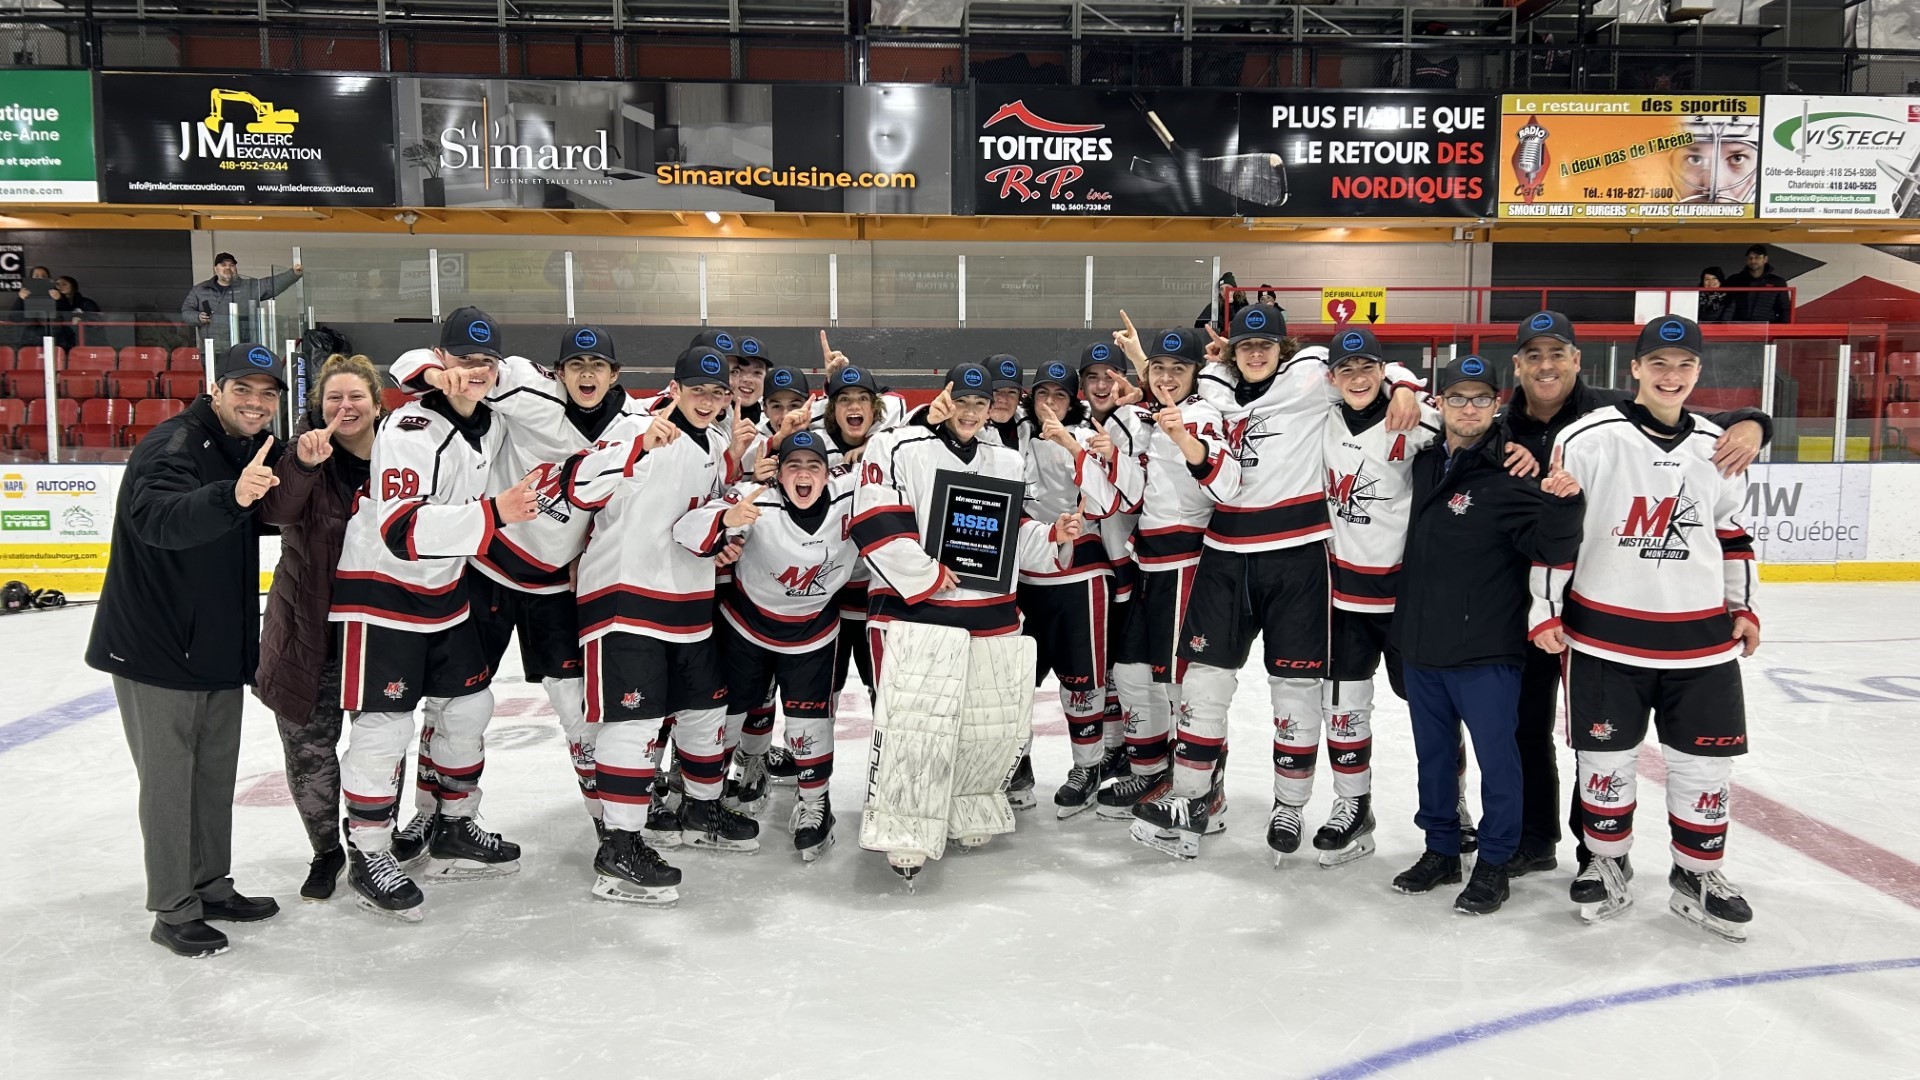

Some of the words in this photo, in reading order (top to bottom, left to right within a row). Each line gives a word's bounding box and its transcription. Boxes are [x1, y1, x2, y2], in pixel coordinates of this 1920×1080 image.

[1515, 98, 1537, 113] Le
[1542, 98, 1630, 113] restaurant
[1641, 97, 1673, 113] des
[1680, 97, 1747, 115] sportifs
[1272, 105, 1337, 129] PLUS
[1432, 107, 1485, 134] QUE
[1518, 124, 1547, 139] RADIO
[1805, 129, 1906, 146] VISTECH
[236, 133, 294, 146] LECLERC
[237, 147, 322, 160] EXCAVATION
[439, 126, 613, 172] Simard
[978, 135, 1113, 163] TOITURES
[1294, 141, 1323, 164] LE
[1328, 141, 1431, 164] RETOUR
[1437, 142, 1485, 165] DES
[7, 156, 18, 166] et
[19, 156, 62, 168] sportive
[219, 160, 289, 171] 418-952-6244
[1559, 164, 1569, 178] A
[1571, 155, 1602, 174] deux
[1604, 150, 1628, 168] pas
[1629, 143, 1646, 160] de
[656, 164, 917, 188] SimardCuisine.com
[1765, 166, 1826, 177] Côte-de-Beaupré
[1843, 168, 1877, 177] 254-9388
[129, 181, 246, 193] info@jmleclercexcavation.com
[257, 183, 375, 194] www.jmleclercexcavation.com
[545, 178, 570, 186] SALLE
[1788, 180, 1825, 189] Charlevoix
[1843, 181, 1877, 190] 240-5625
[1331, 176, 1484, 204] NORDIQUES
[1513, 182, 1545, 198] Café
[1605, 188, 1673, 199] 418-827-1800
[1508, 204, 1547, 216] SMOKED
[1549, 204, 1574, 216] MEAT
[1586, 204, 1627, 217] BURGERS
[1638, 204, 1670, 217] PIZZAS
[1672, 204, 1745, 217] CALIFORNIENNES
[0, 252, 20, 272] C
[11, 281, 22, 289] 33
[1324, 290, 1384, 298] DÉFIBRILLATEUR
[1341, 441, 1363, 450] CCM
[1387, 433, 1406, 462] A
[3, 479, 24, 491] NAPA
[36, 480, 97, 491] AUTOPRO
[381, 467, 420, 500] 68
[951, 512, 999, 532] RSEQ
[1622, 496, 1679, 538] M
[956, 528, 992, 538] HOCKEY
[1777, 520, 1860, 543] Québec
[801, 539, 824, 547] CCM
[1617, 537, 1664, 548] MISTRAL
[1644, 550, 1686, 559] MONT-JOLI
[1274, 658, 1324, 669] CCM
[785, 699, 827, 710] CCM
[1694, 734, 1746, 747] CCM
[866, 728, 883, 804] TRUE
